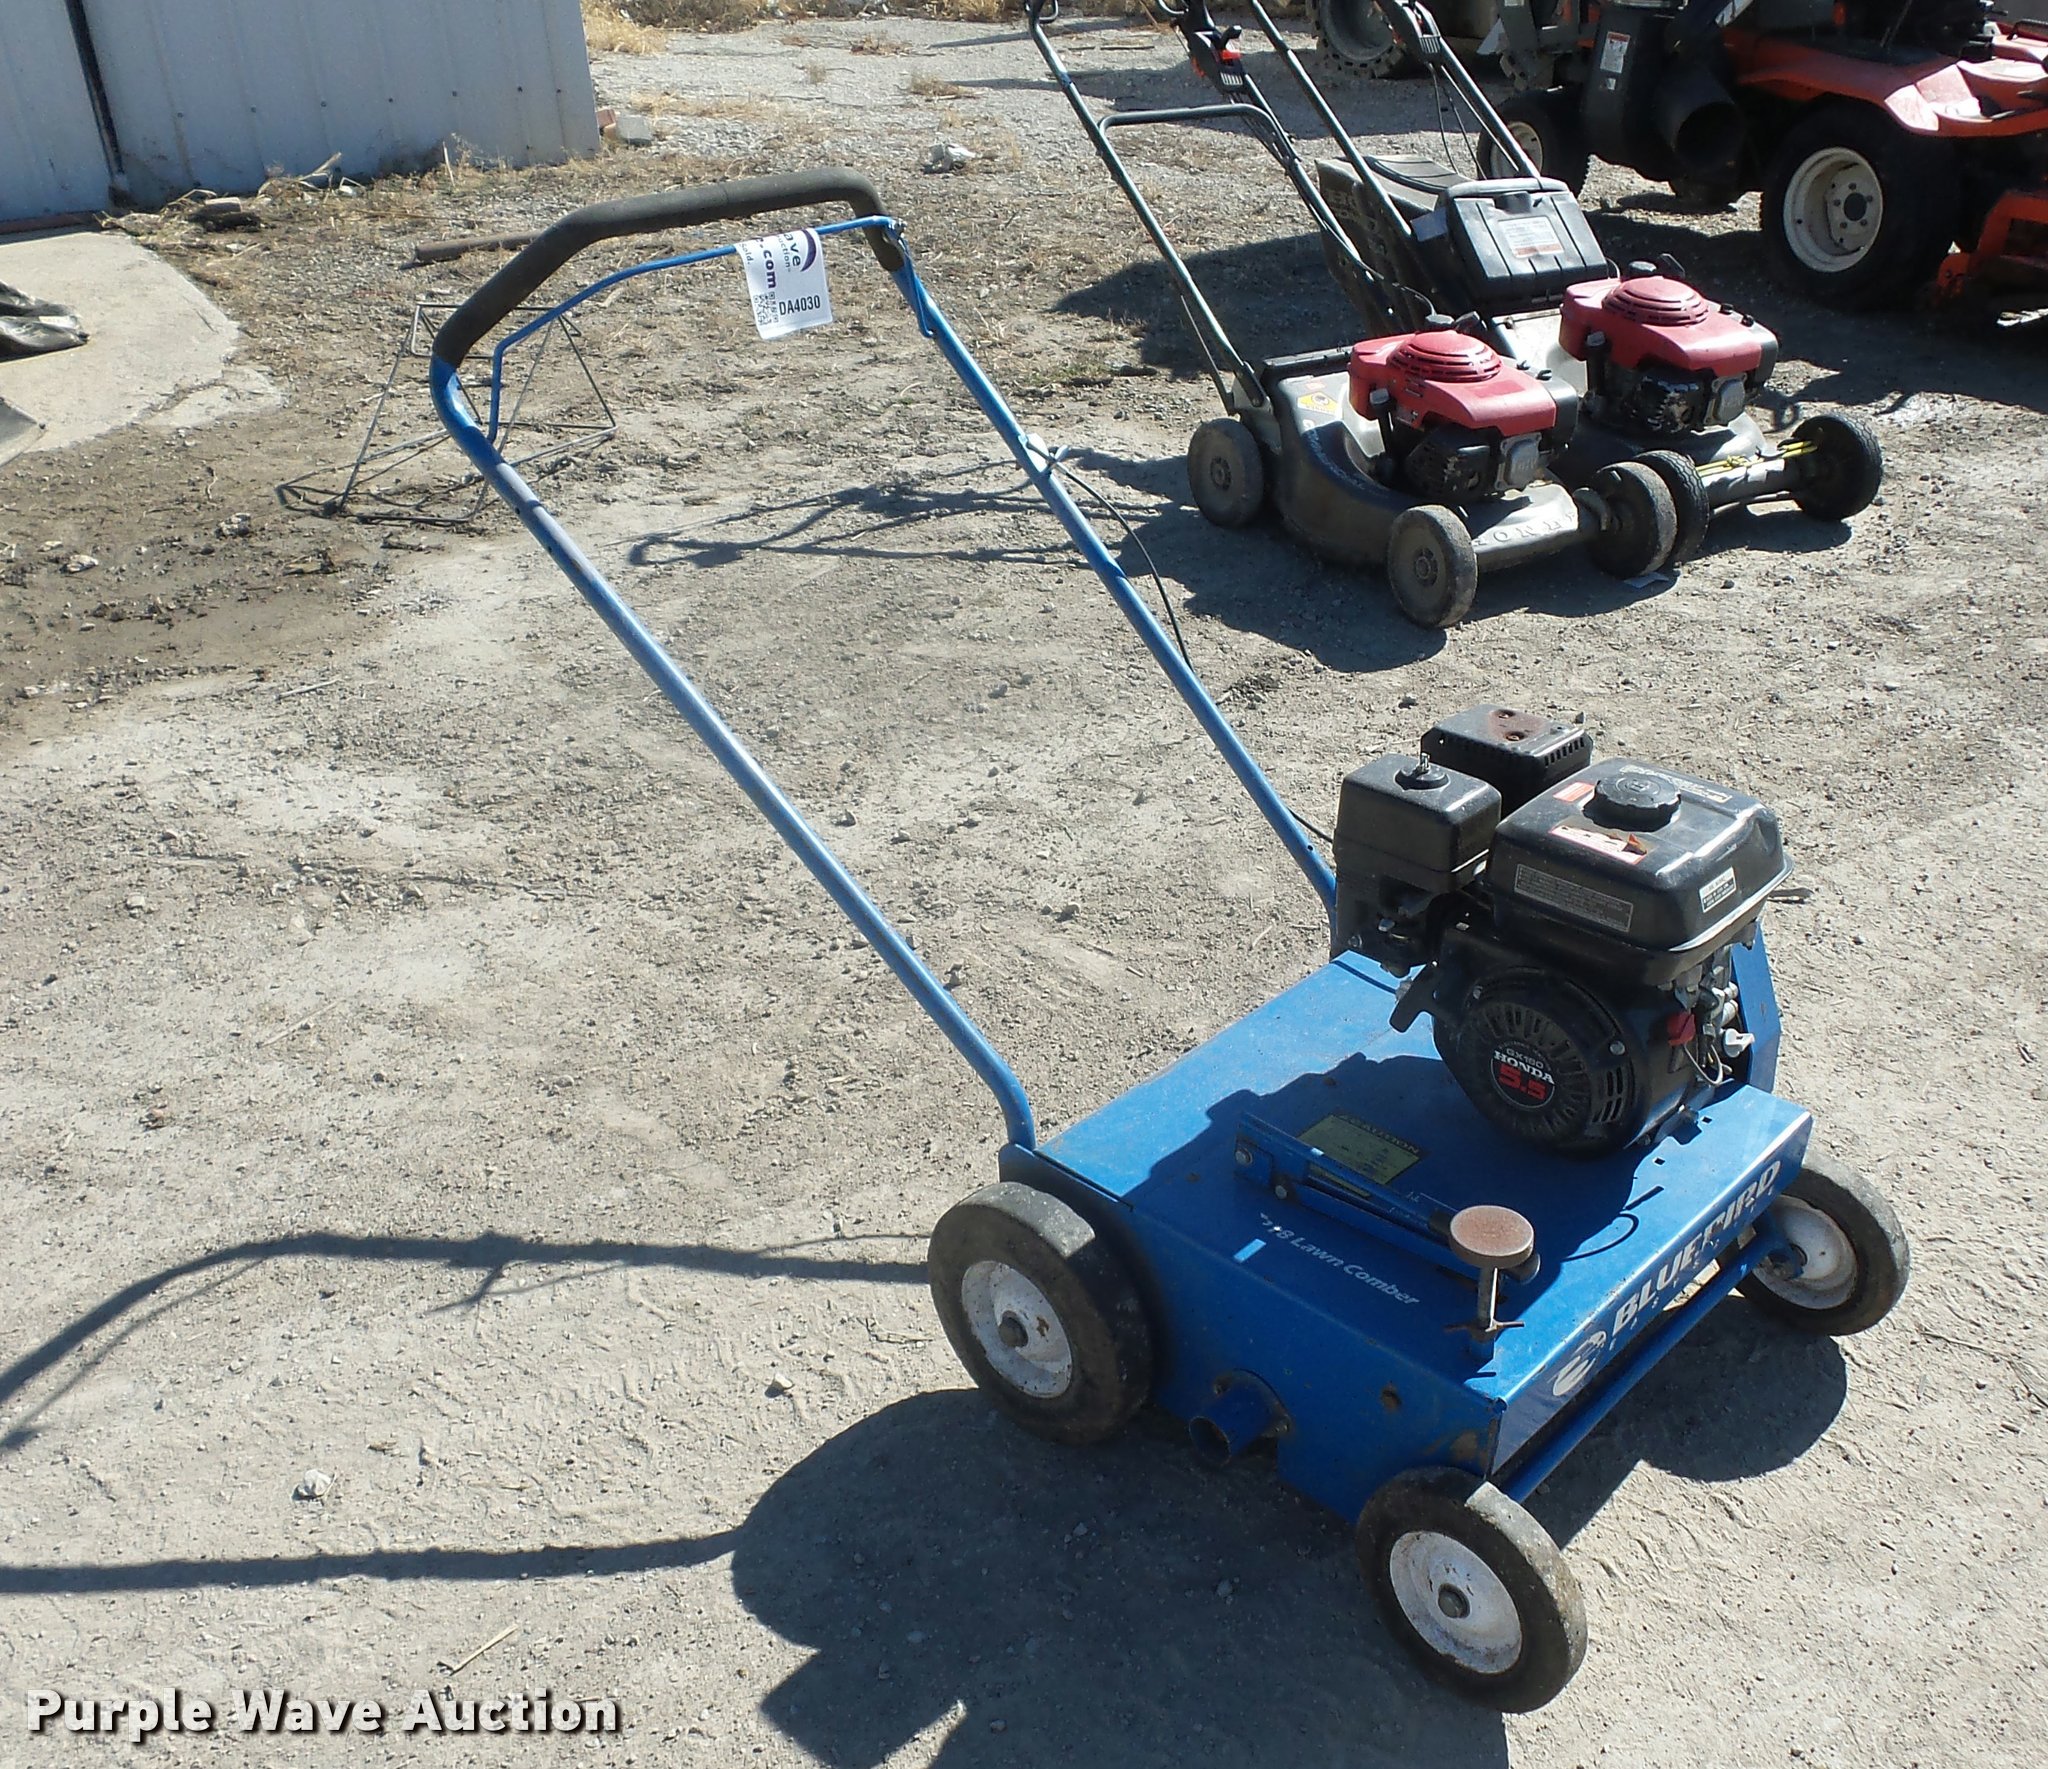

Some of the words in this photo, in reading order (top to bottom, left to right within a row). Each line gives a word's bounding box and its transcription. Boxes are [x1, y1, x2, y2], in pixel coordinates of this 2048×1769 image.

[779, 295, 821, 316] DA4030
[1494, 1050, 1555, 1085] HONDA
[1499, 1063, 1547, 1100] 5.5
[1290, 1237, 1344, 1267] Lawn
[1343, 1264, 1420, 1304] Comber
